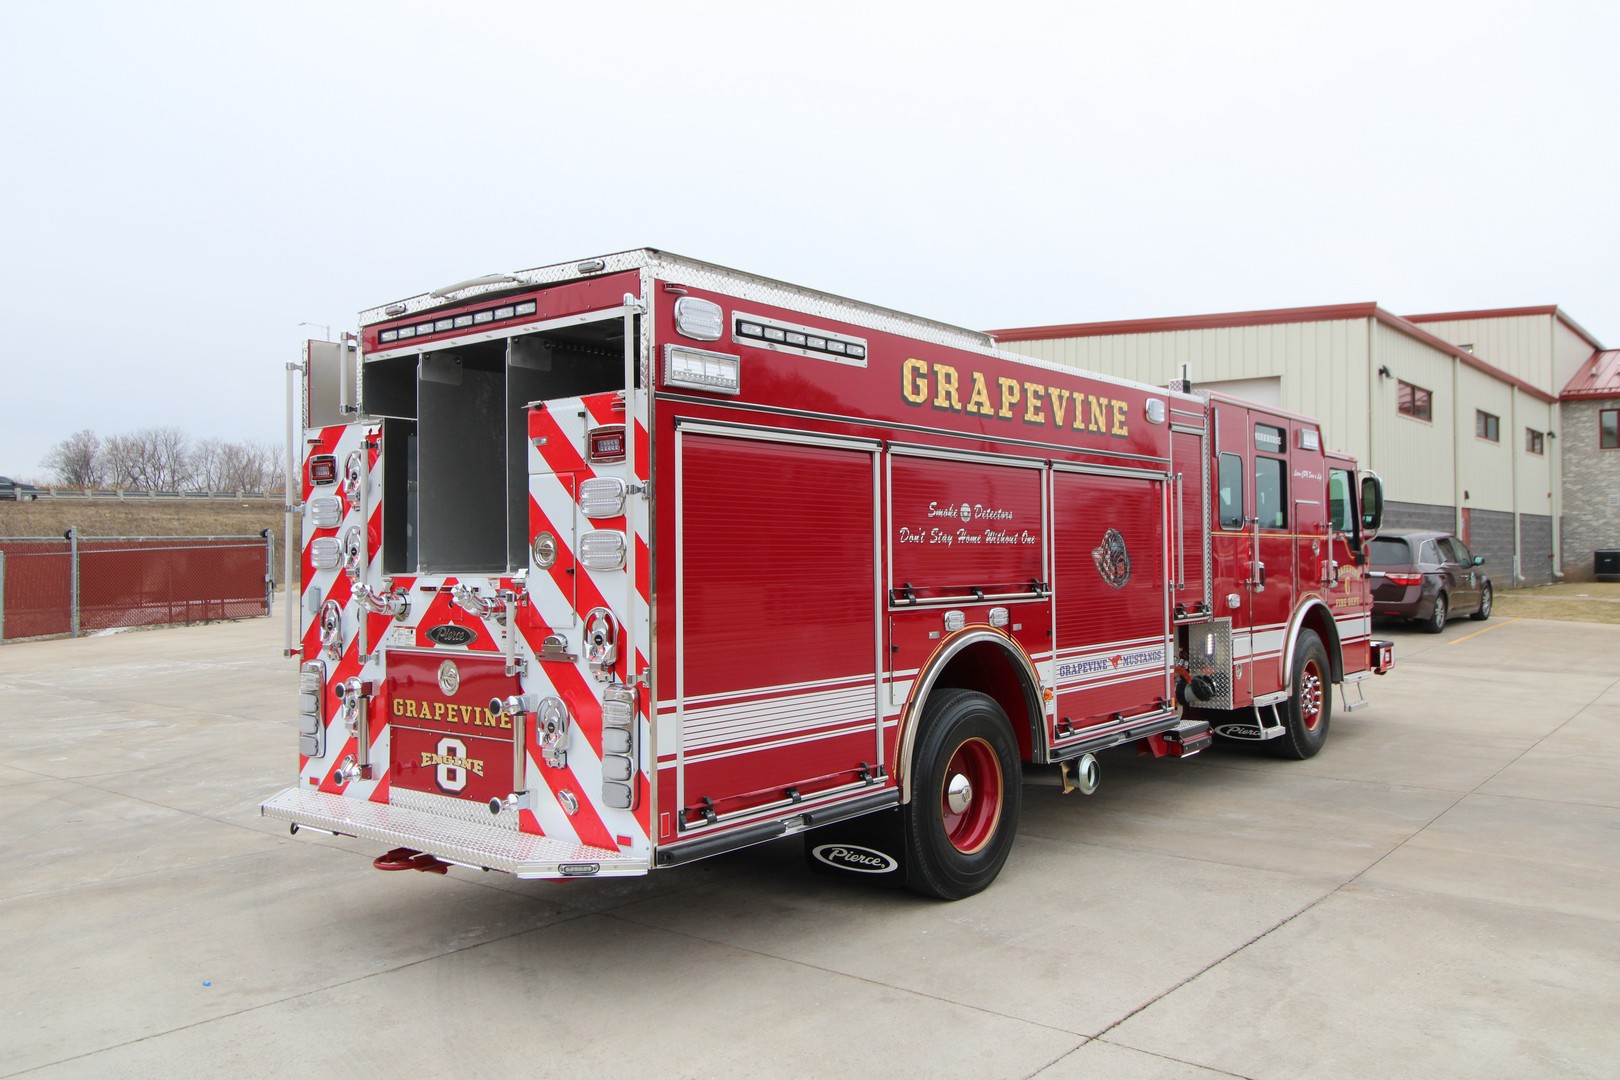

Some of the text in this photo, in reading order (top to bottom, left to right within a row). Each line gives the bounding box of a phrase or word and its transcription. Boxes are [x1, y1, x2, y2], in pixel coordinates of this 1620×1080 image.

[903, 358, 1128, 437] GRAPEVINE
[928, 501, 1013, 520] Smoke Detectors
[899, 527, 1036, 548] Don't Stay Home Without One
[437, 626, 466, 641] Pierce
[1060, 650, 1162, 677] GRAPEVINE MUSTANGS
[393, 698, 512, 729] GRAPEVINE
[1226, 726, 1261, 736] Pierc
[421, 752, 484, 777] ENGINE
[828, 847, 882, 867] Pierce
